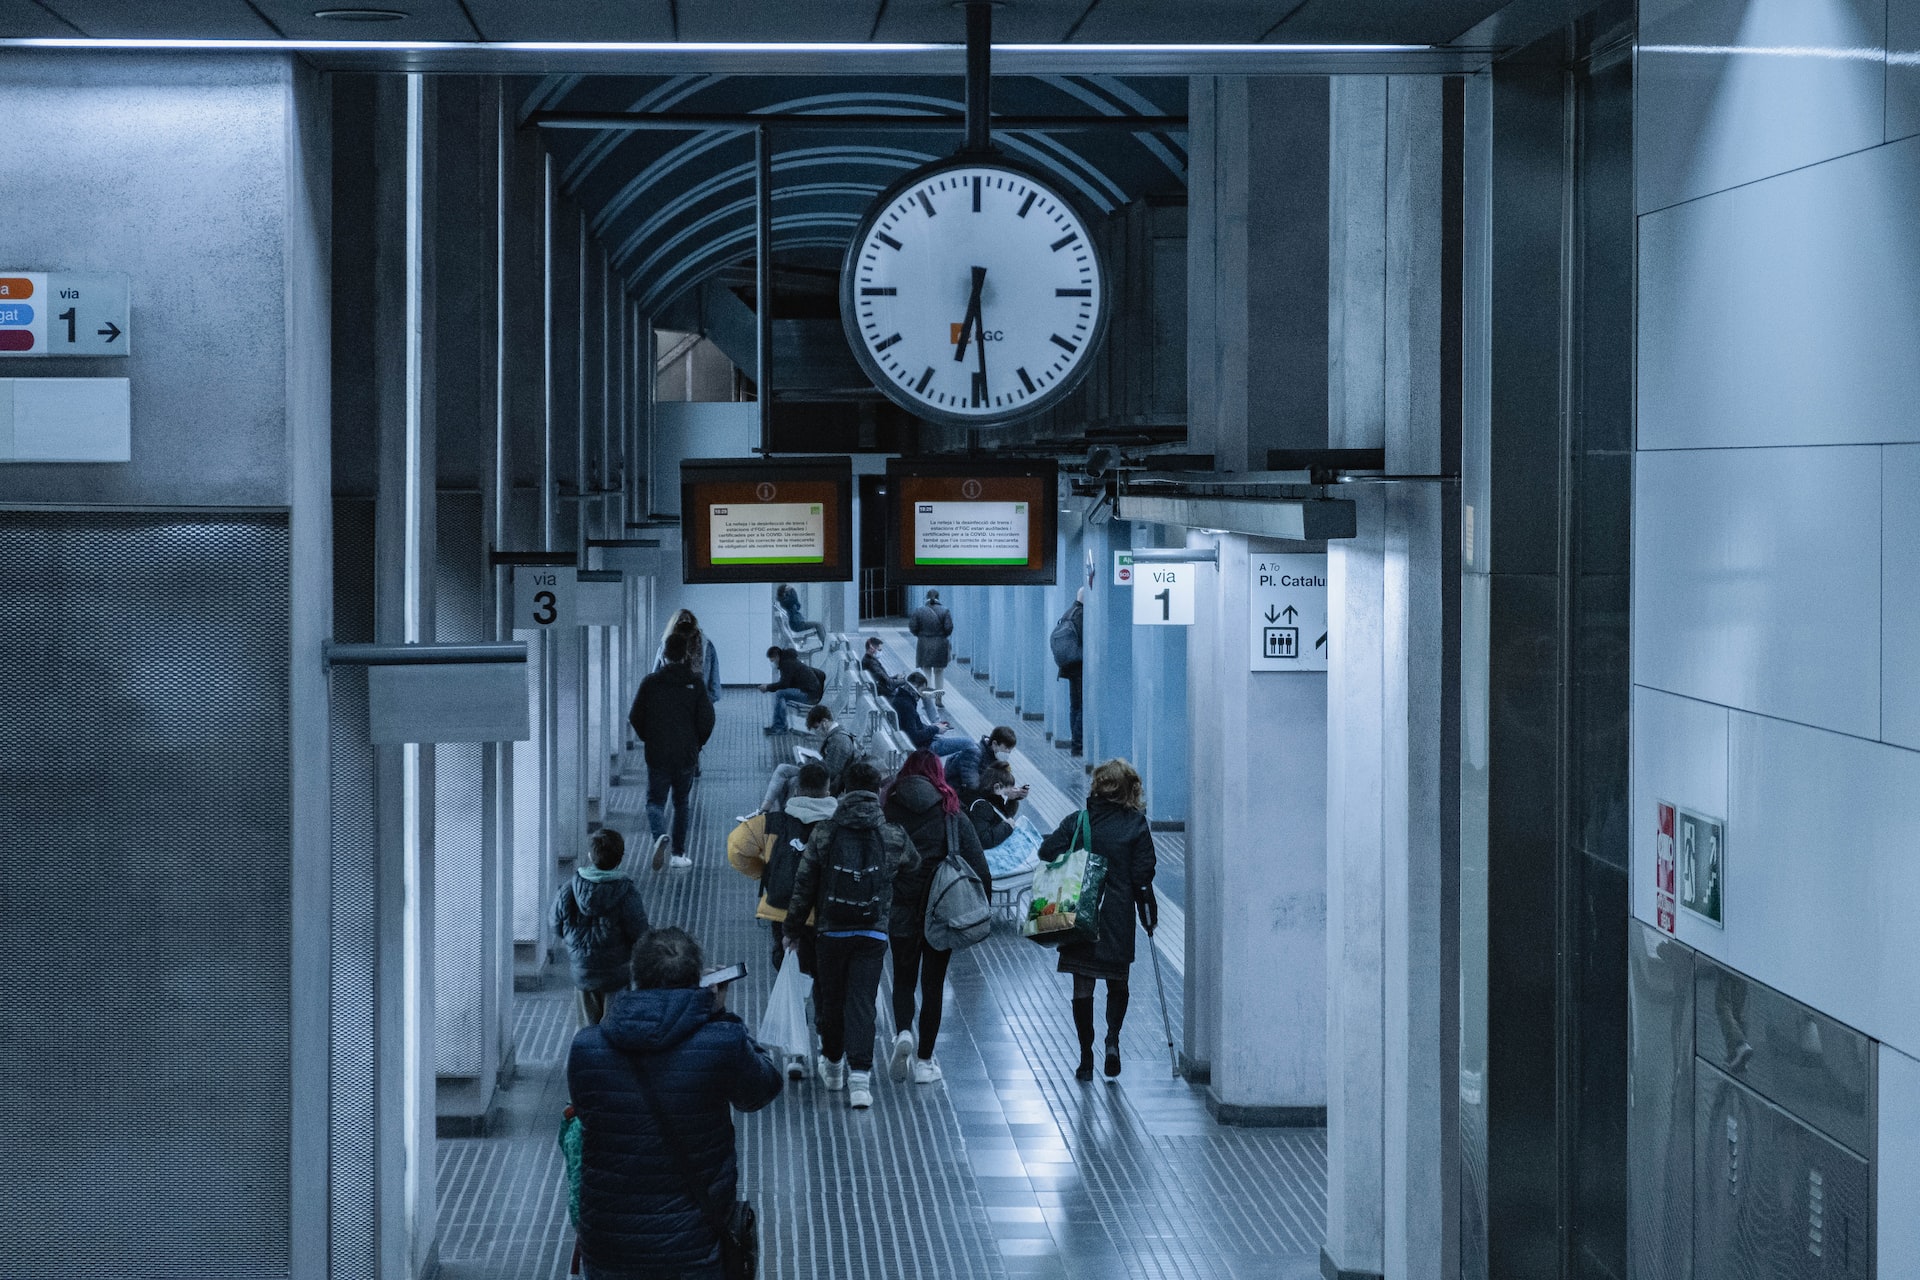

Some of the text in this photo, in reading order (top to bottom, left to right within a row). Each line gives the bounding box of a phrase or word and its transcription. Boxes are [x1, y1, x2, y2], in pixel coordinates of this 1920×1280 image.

[60, 288, 79, 299] via
[59, 308, 76, 342] 1
[976, 330, 1004, 342] GC
[1270, 563, 1280, 571] To
[534, 572, 556, 585] via
[1153, 569, 1176, 582] via
[1260, 575, 1327, 586] Pl. Catalu
[533, 591, 557, 624] 3
[1155, 589, 1169, 620] 1
